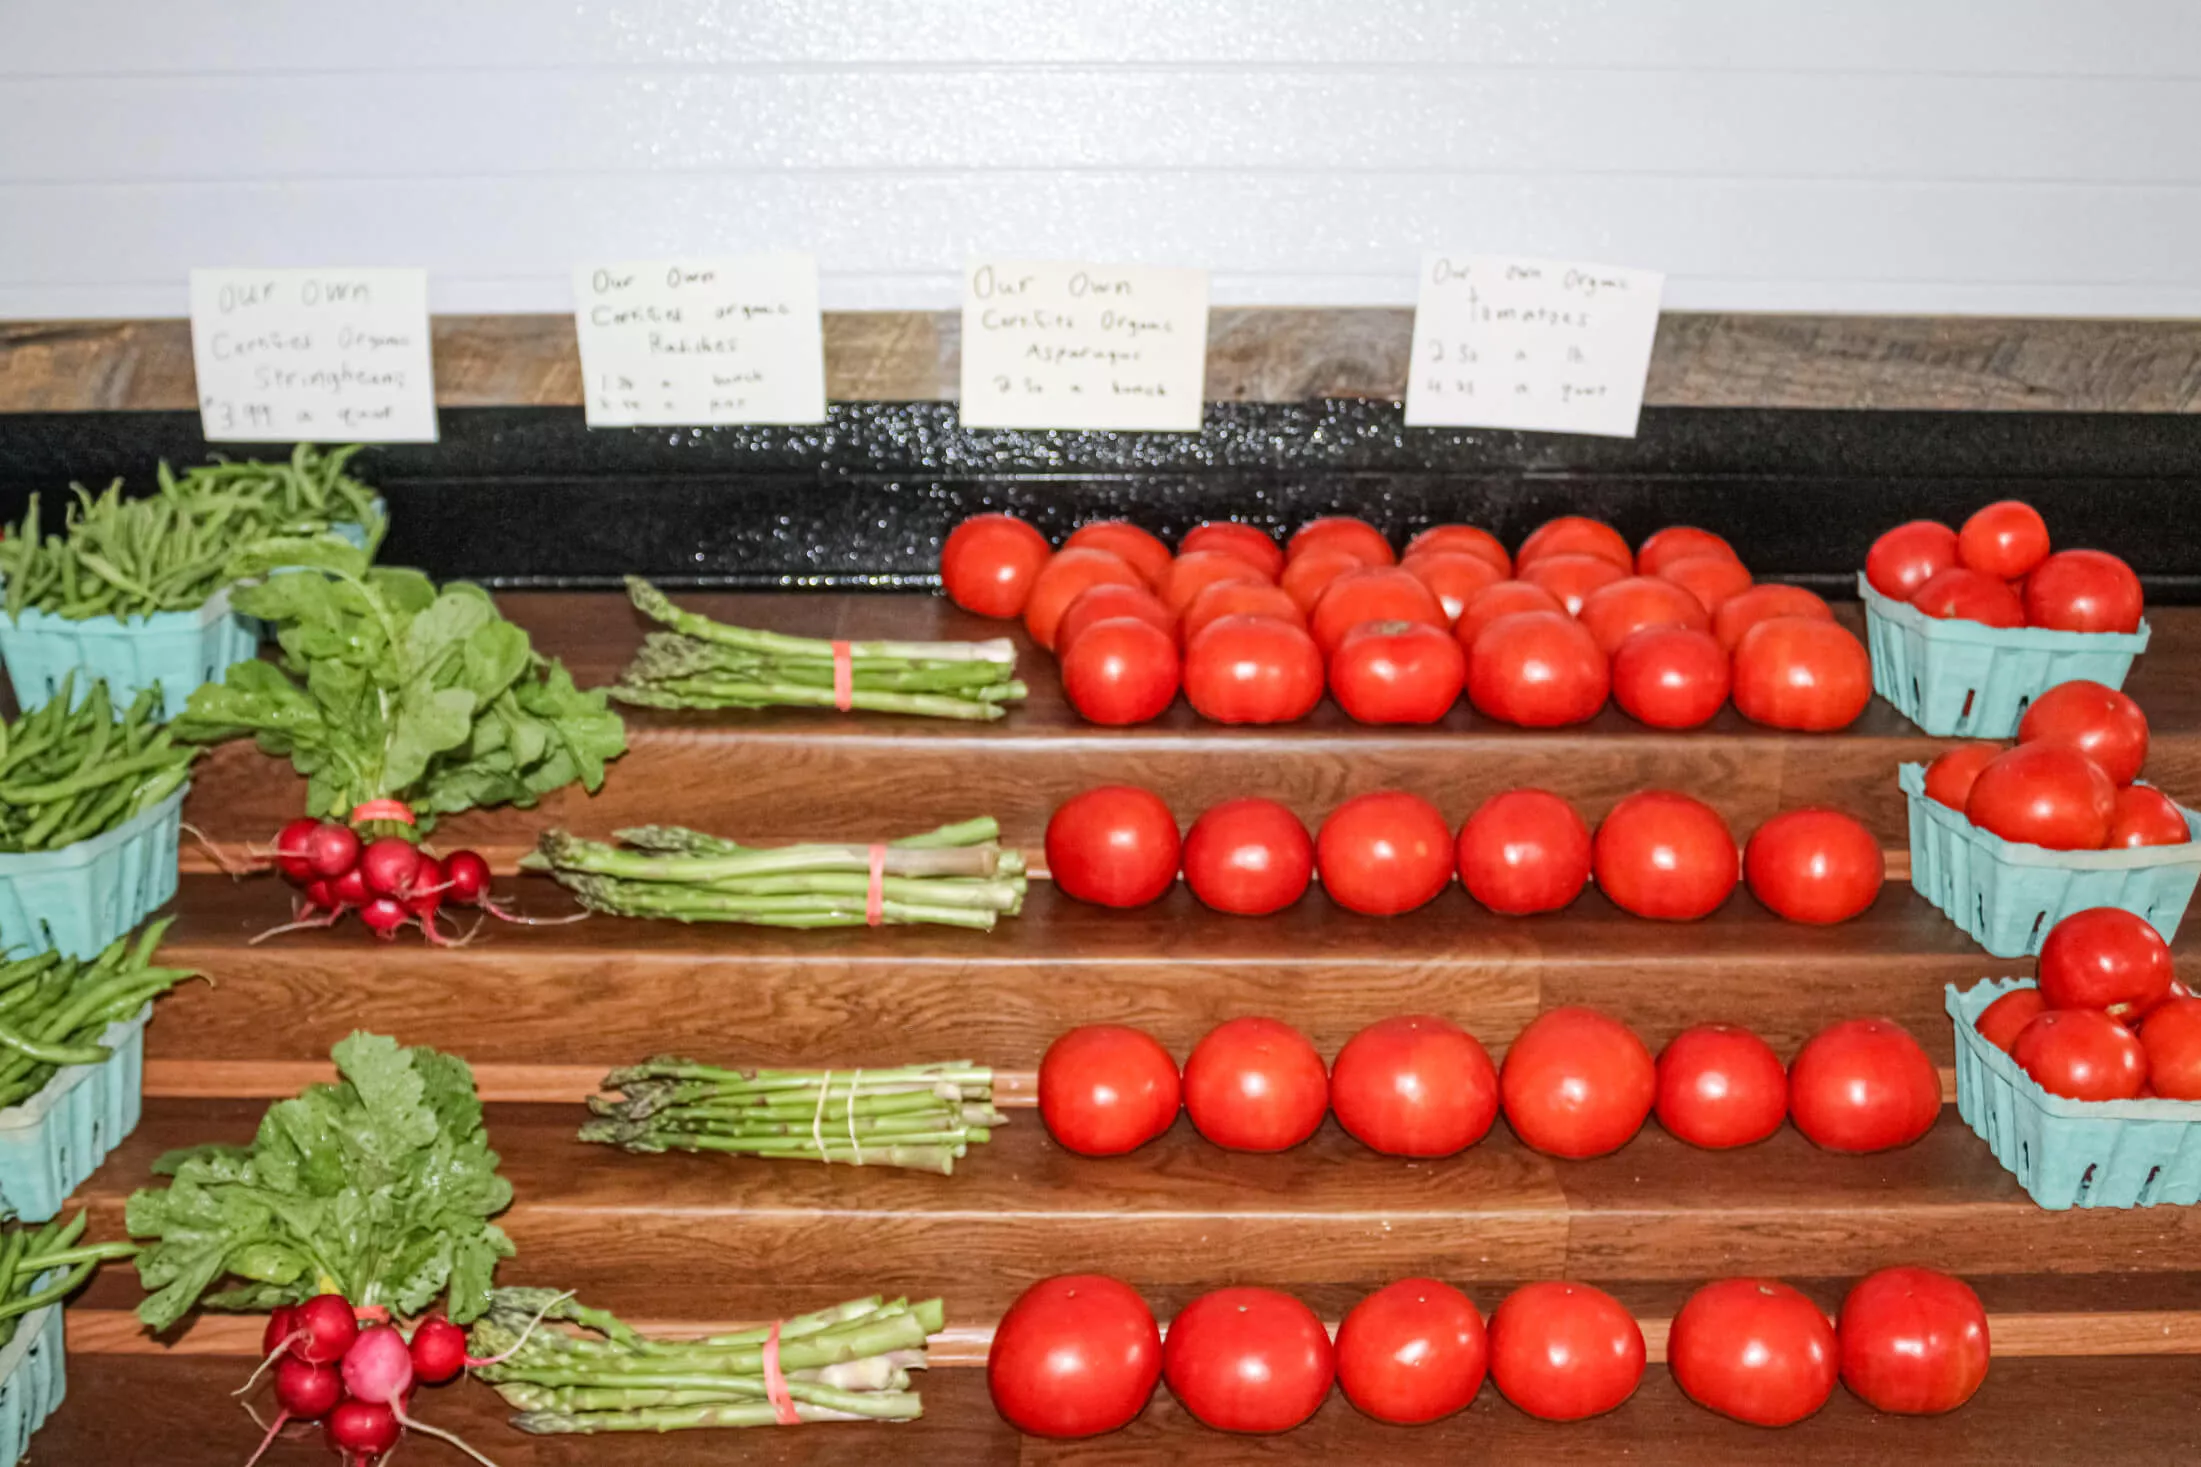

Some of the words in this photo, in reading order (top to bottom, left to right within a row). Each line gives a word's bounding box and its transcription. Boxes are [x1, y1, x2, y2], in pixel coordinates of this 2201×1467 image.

[594, 269, 633, 294] Our
[667, 267, 715, 289] Own
[973, 264, 1034, 299] Our
[1068, 271, 1132, 298] Own
[1433, 258, 1470, 284] Our
[220, 282, 274, 313] Our
[302, 280, 369, 306] Own
